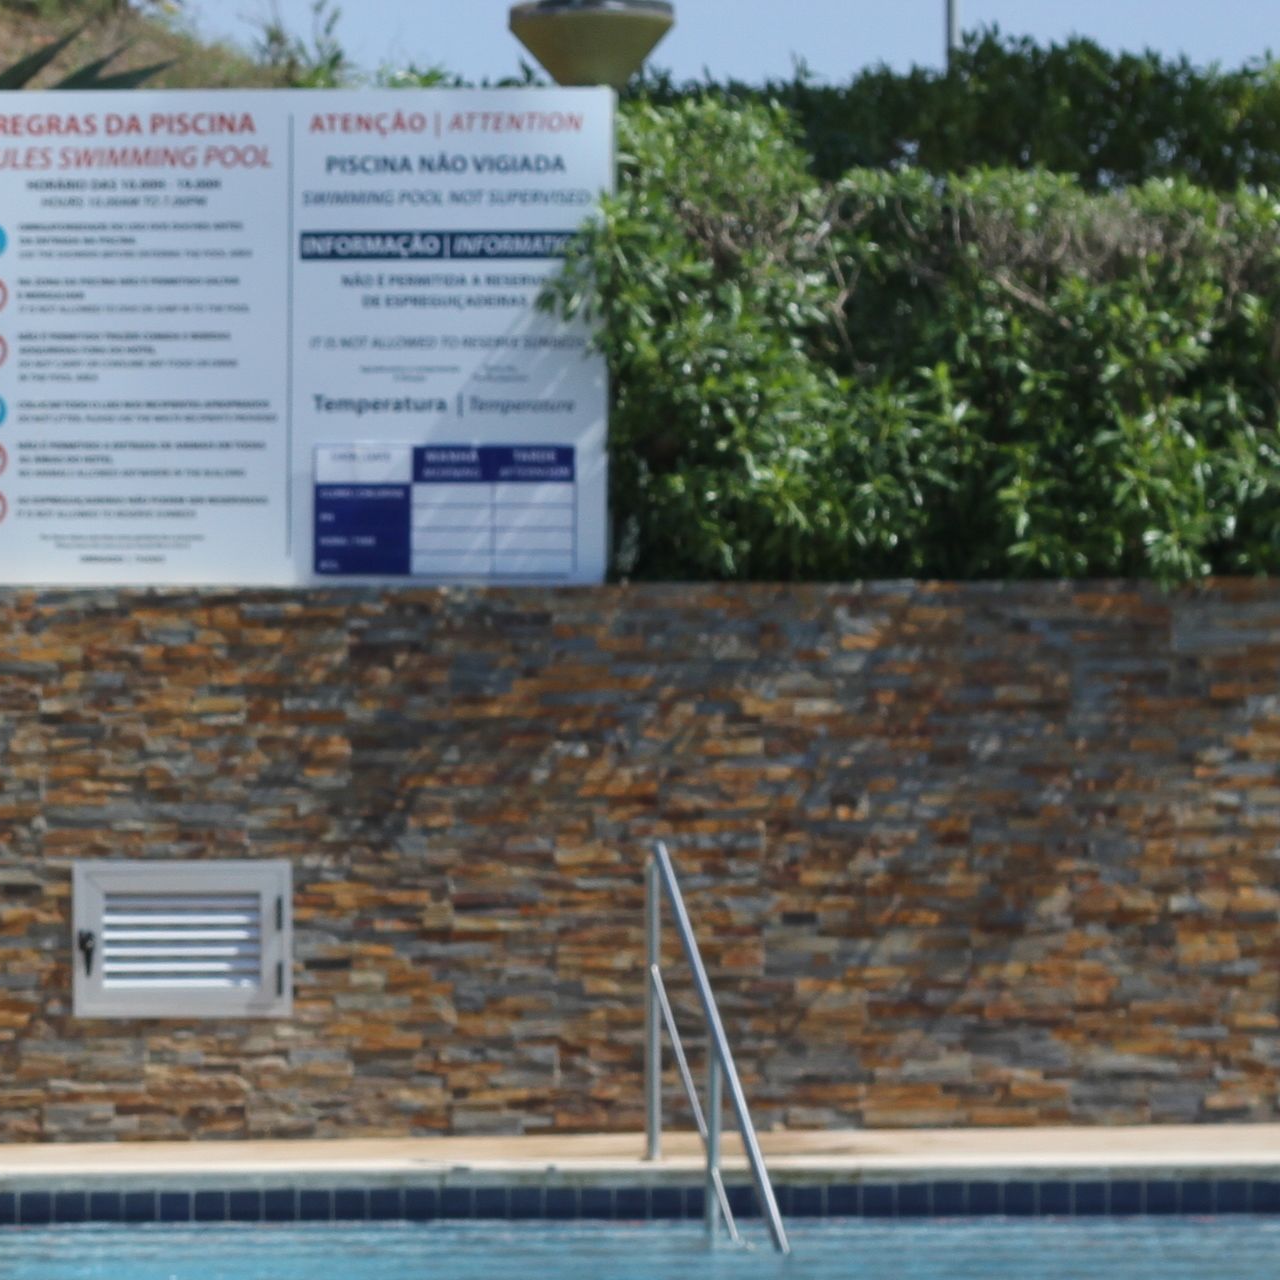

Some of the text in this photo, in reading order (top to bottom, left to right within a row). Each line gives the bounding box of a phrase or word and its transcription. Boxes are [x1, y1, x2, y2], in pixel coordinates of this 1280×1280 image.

[105, 113, 142, 136] DA
[150, 112, 256, 135] PISCINA
[310, 109, 583, 139] ATENÇÃO ATTENTION
[58, 146, 198, 170] SWIMMING
[203, 145, 274, 169] POOL
[326, 151, 566, 174] PISCINA NÃO VIGIADA
[302, 188, 591, 207] SWIMMING POOL NOT SUPERVISED
[302, 233, 440, 258] INFORMAÇÃO
[313, 393, 576, 418] Temperatura Temperature
